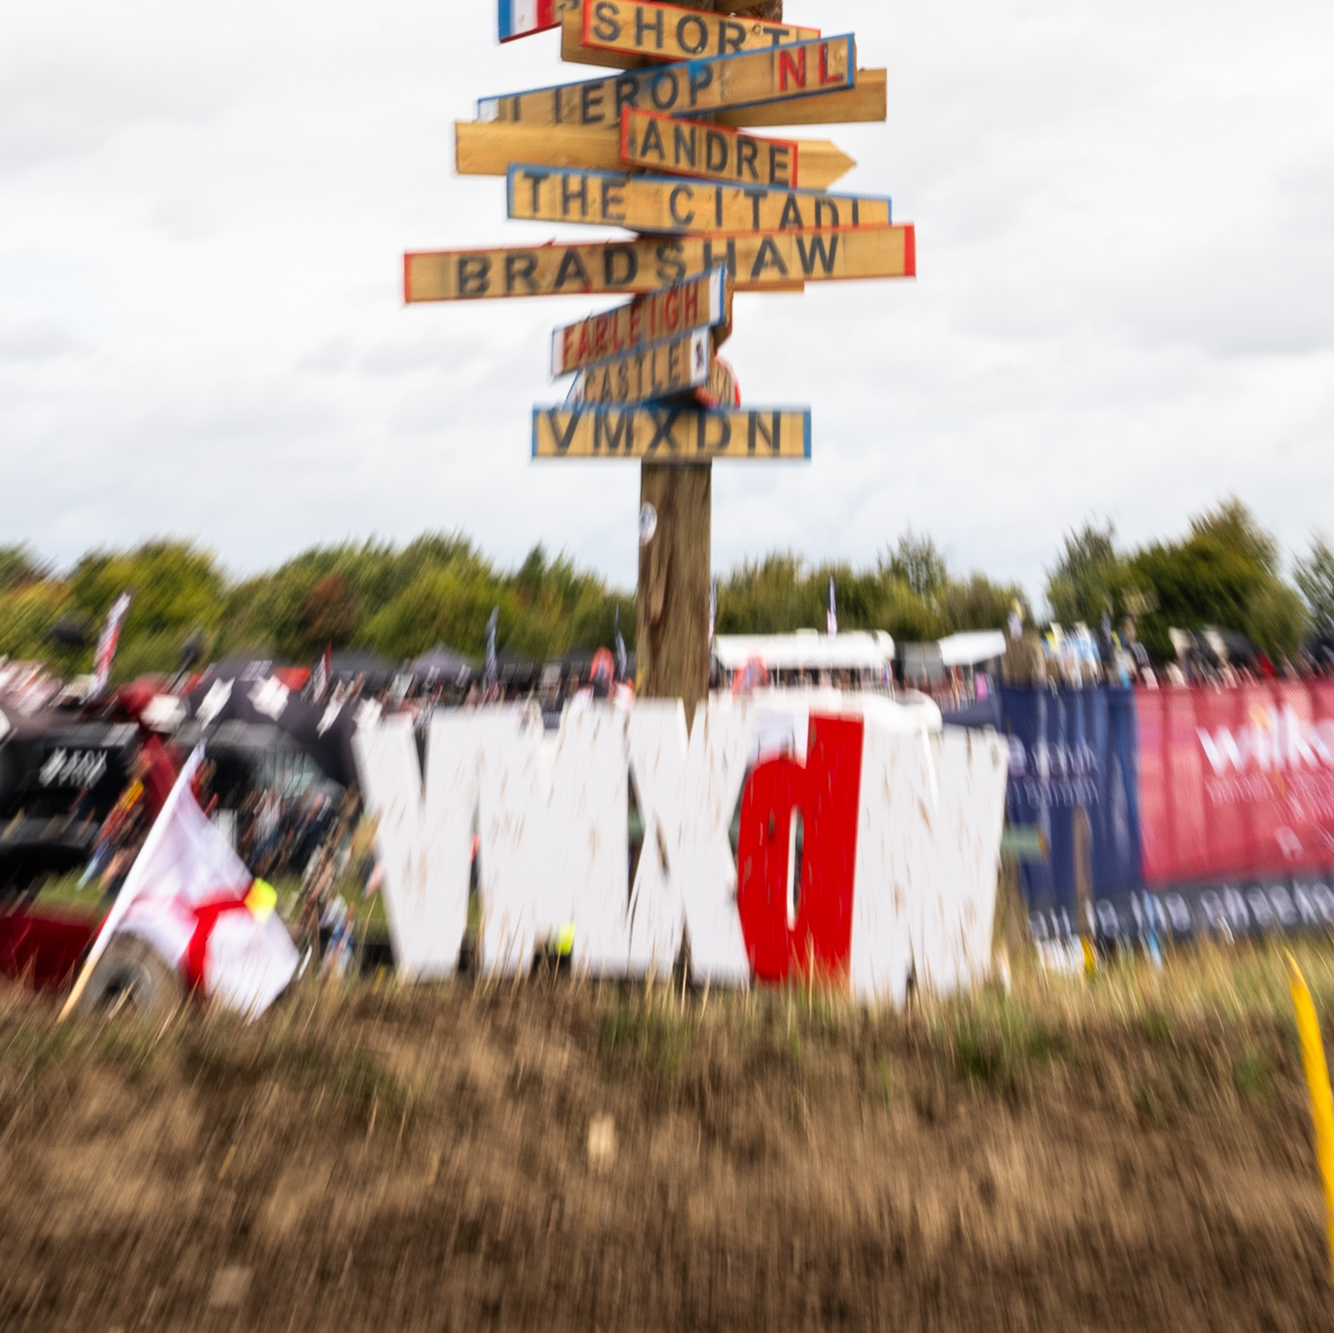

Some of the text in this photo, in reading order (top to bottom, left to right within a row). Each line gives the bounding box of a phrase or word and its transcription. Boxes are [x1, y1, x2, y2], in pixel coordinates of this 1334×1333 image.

[591, 1, 790, 55] SHORT
[778, 43, 844, 92] NL
[640, 118, 790, 185] ANDRE
[520, 171, 627, 222] THE
[457, 234, 839, 297] BRADSHAW
[563, 281, 699, 361] FARLEIGH
[548, 407, 782, 456] VMXDN
